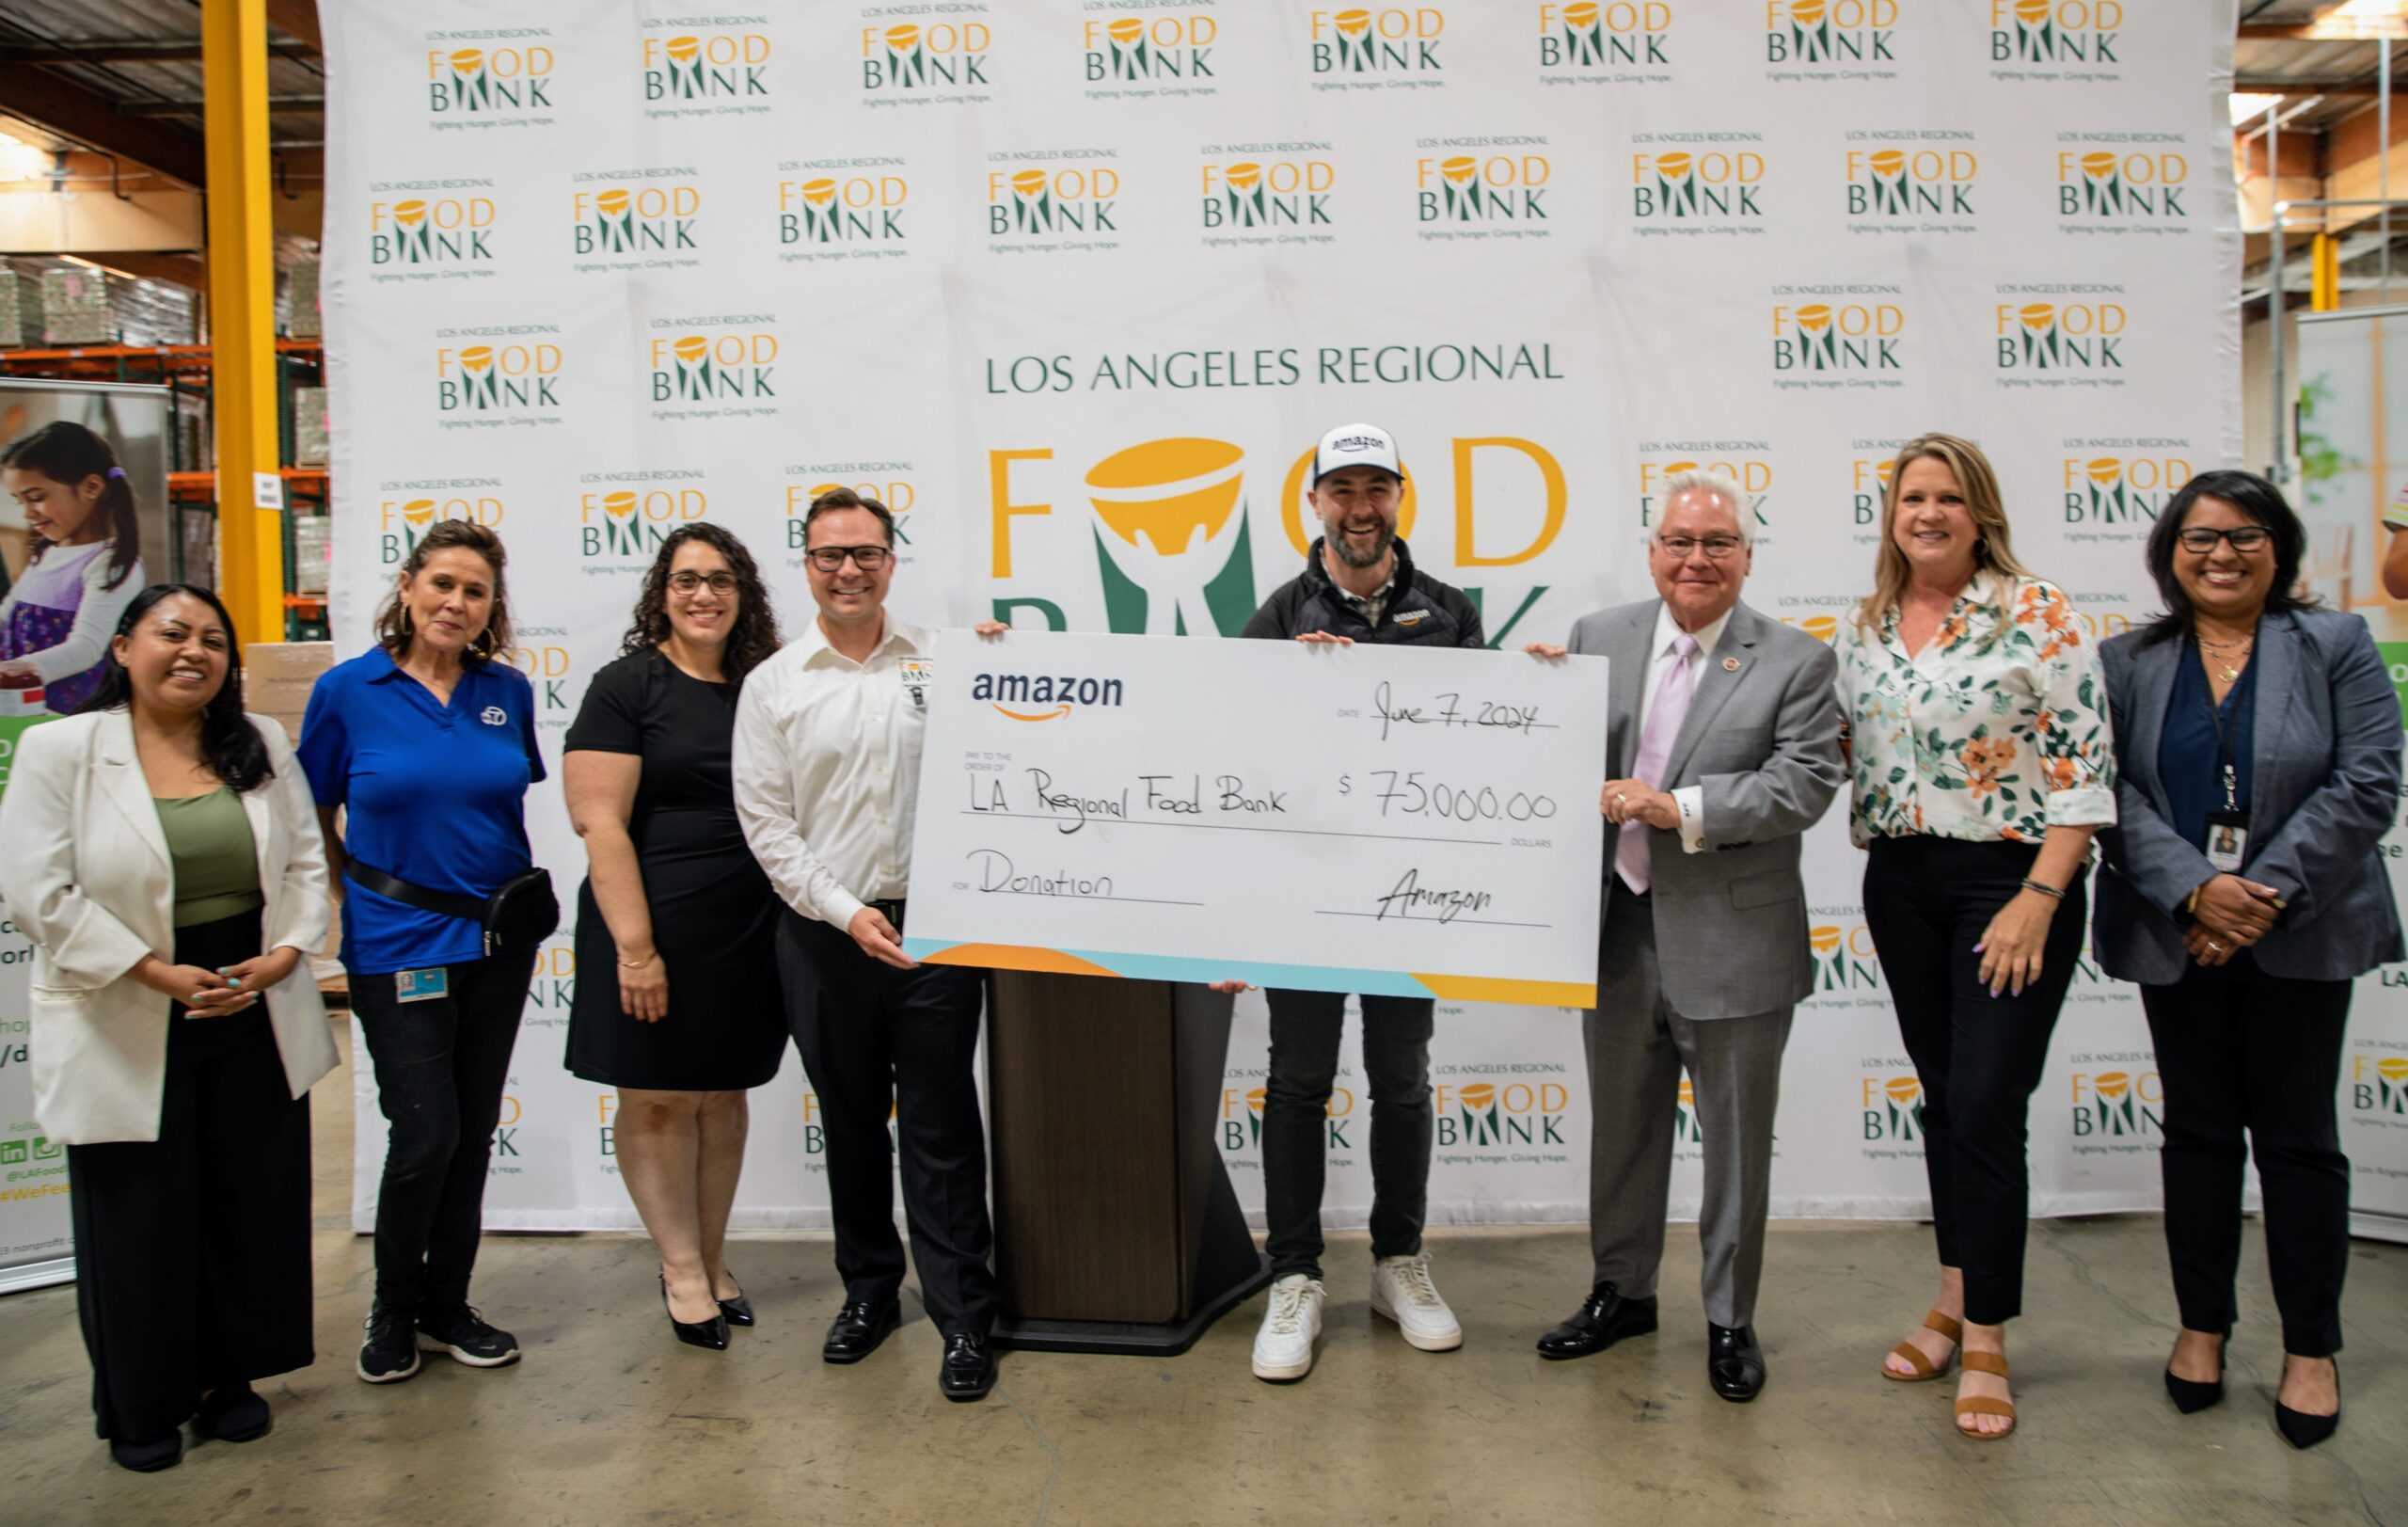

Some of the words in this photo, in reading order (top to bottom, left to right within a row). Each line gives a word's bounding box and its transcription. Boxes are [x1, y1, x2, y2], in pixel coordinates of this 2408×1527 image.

[862, 7, 882, 17] LOS
[885, 4, 932, 16] ANGELES
[935, 2, 989, 13] REGIONAL
[1201, 144, 1223, 154] LOS
[1226, 142, 1274, 153] ANGELES
[1276, 140, 1333, 151] REGIONAL
[651, 318, 671, 328] LOS
[674, 315, 721, 327] ANGELES
[723, 313, 777, 325] REGIONAL
[987, 356, 1073, 393] LOS
[1090, 349, 1301, 390] ANGELES
[1319, 342, 1564, 385] REGIONAL
[1332, 436, 1386, 450] amazon
[1640, 440, 1660, 451] LOS
[1664, 439, 1711, 450] ANGELES
[1714, 439, 1770, 450] REGIONAL
[2063, 437, 2083, 447] LOS
[2087, 436, 2133, 446] ANGELES
[2137, 436, 2192, 446] REGIONAL
[785, 465, 805, 475] LOS
[809, 463, 855, 474] ANGELES
[858, 461, 912, 472] REGIONAL
[381, 481, 401, 491] LOS
[404, 479, 448, 490] ANGELES
[451, 476, 502, 488] REGIONAL
[581, 473, 601, 484] LOS
[604, 470, 649, 482] ANGELES
[652, 469, 705, 480] REGIONAL
[1392, 609, 1431, 623] amazon
[973, 674, 1123, 706] amazon
[1375, 681, 1430, 741] June
[1478, 701, 1540, 735] 2024
[971, 772, 1009, 812] LA
[1025, 768, 1129, 835] Regional
[1138, 774, 1202, 815] Food
[1216, 775, 1289, 814] Bank
[1511, 837, 1552, 848] DOLLARS
[965, 849, 1113, 896] Donation
[1376, 867, 1491, 925] Amazon
[2095, 1052, 2142, 1062] ANGELES
[1436, 1065, 1457, 1074] LOS
[1461, 1064, 1508, 1074] ANGELES
[1511, 1063, 1566, 1074] REGIONAL
[2072, 1072, 2163, 1104] FOO
[7, 1164, 68, 1182] @LAFood
[0, 1183, 71, 1202] #WeFee
